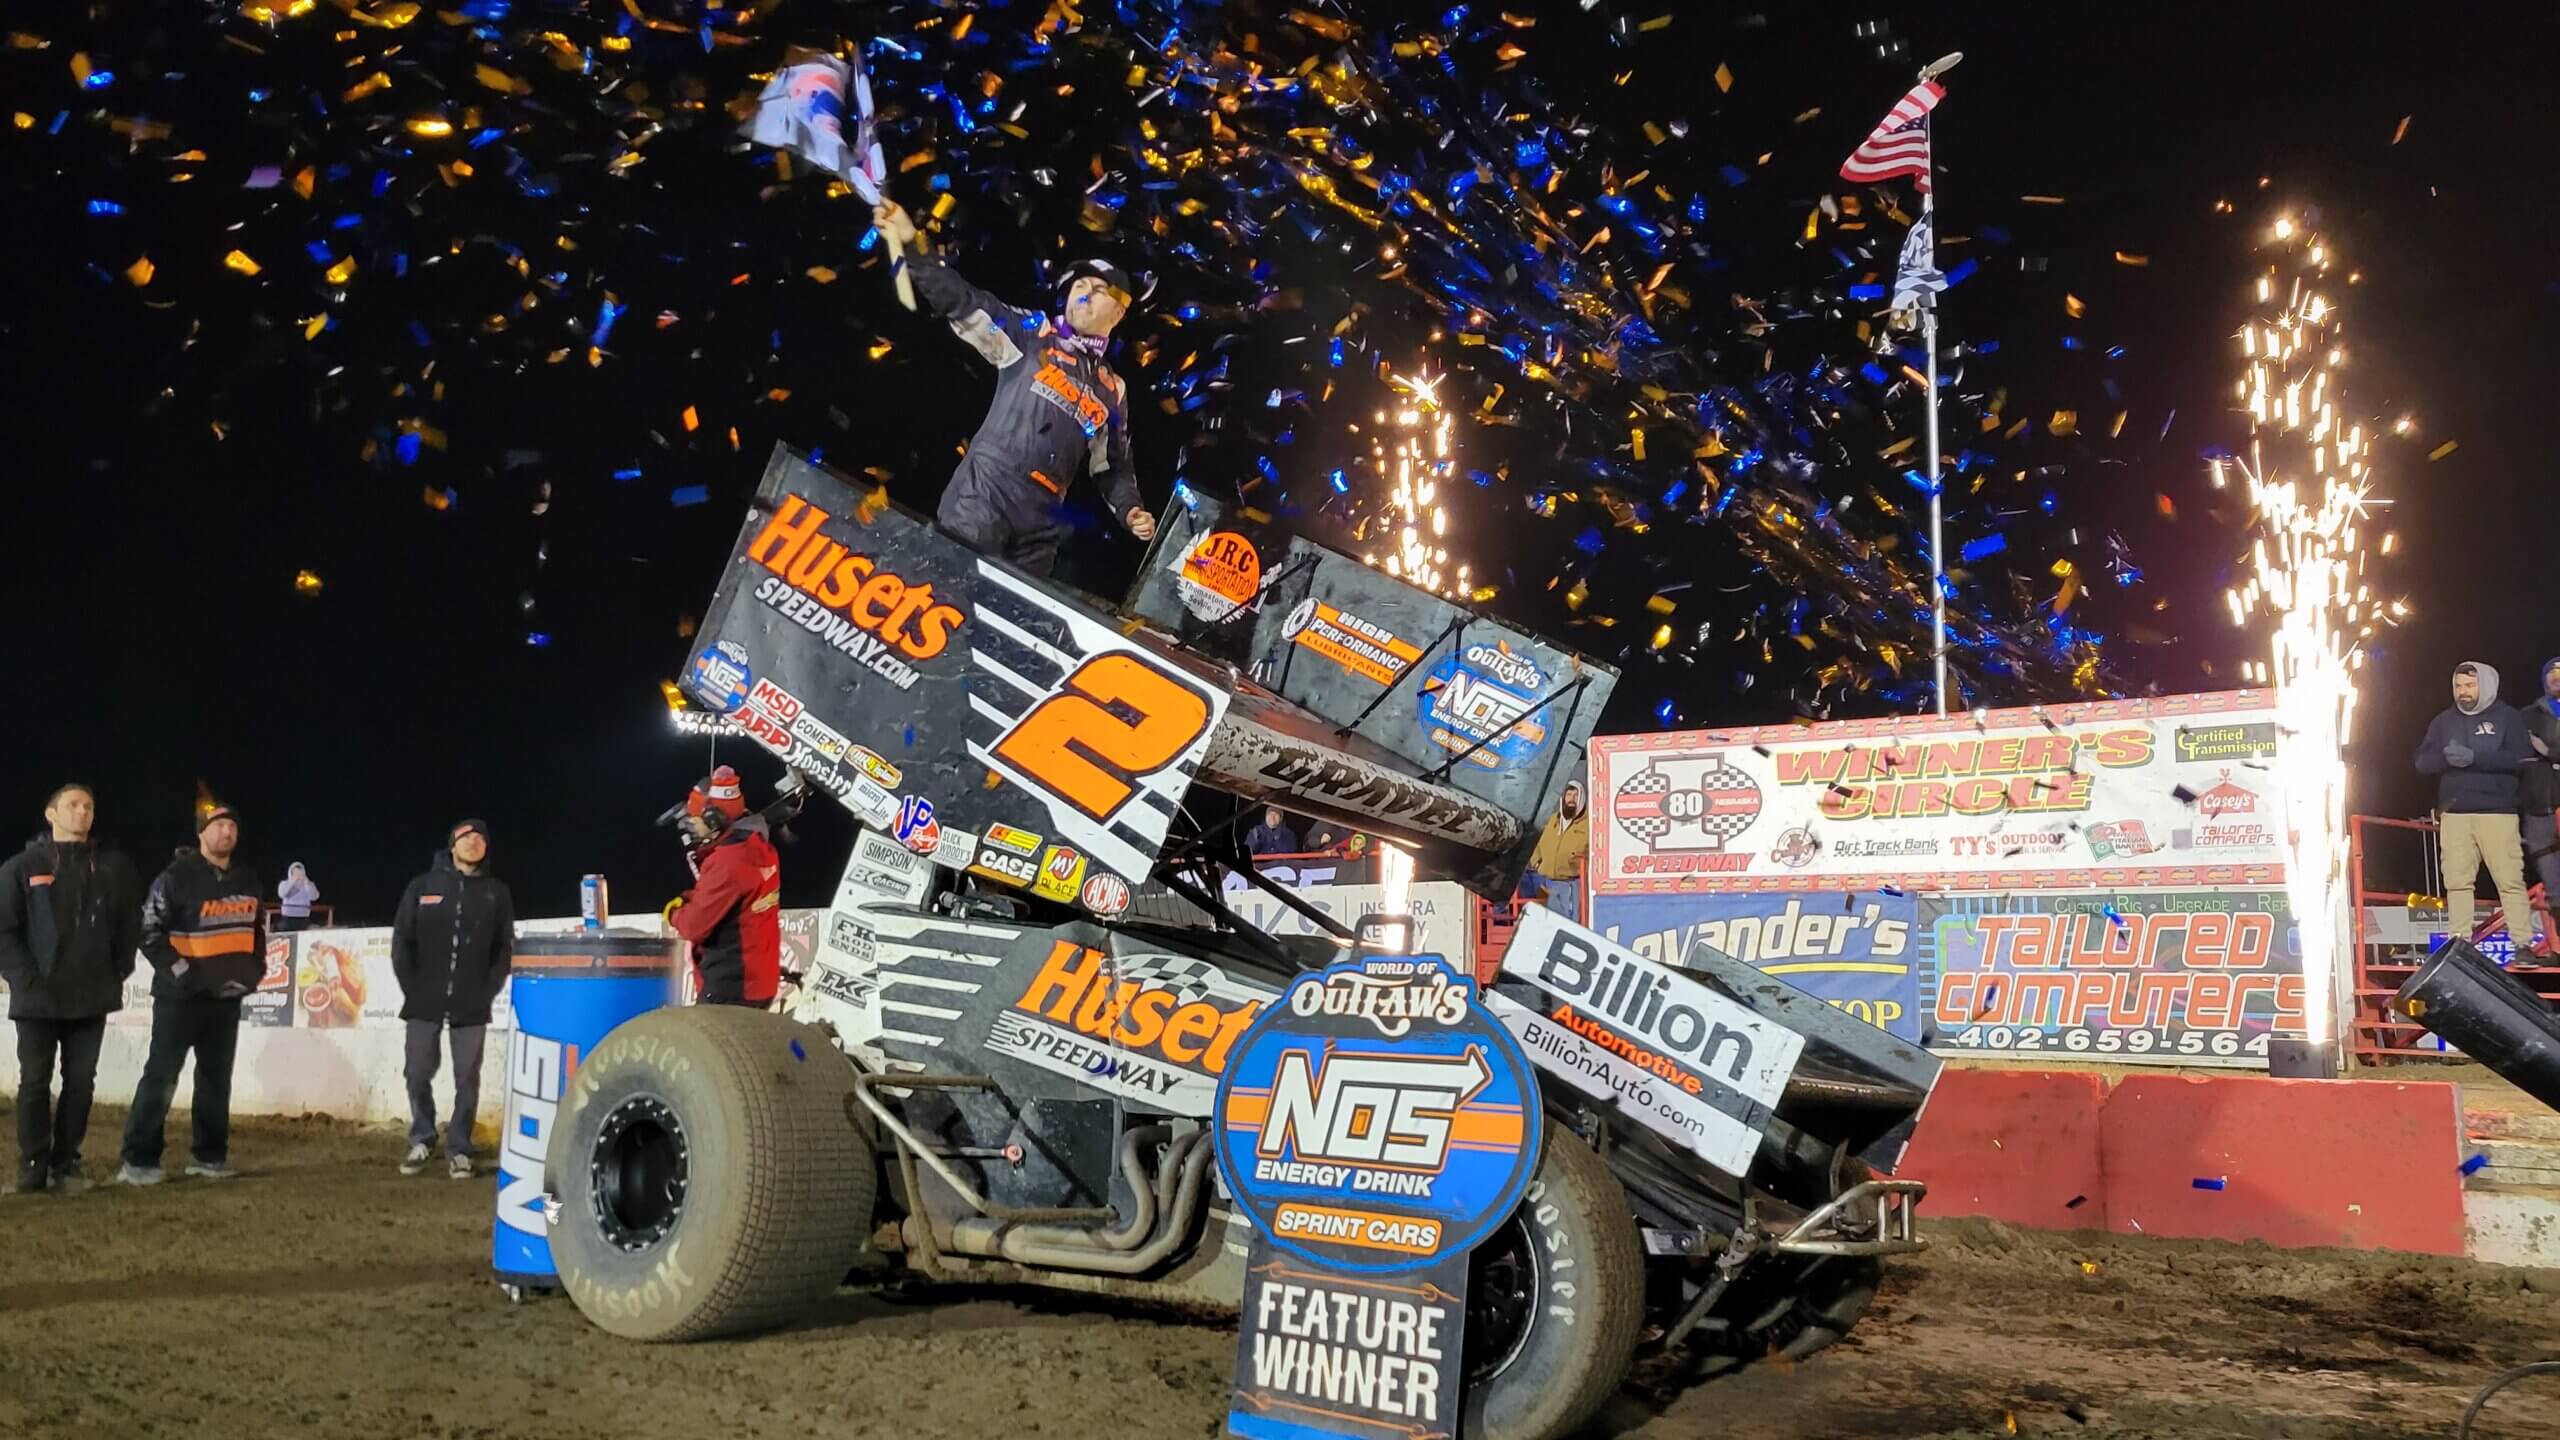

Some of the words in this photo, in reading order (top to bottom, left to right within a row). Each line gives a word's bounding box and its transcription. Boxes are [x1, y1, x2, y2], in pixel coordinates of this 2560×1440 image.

[1204, 537, 1255, 573] J.R.C
[748, 492, 964, 660] Husets
[754, 577, 921, 691] SPEEDWAY.COM
[1337, 611, 1395, 645] HIGH
[703, 655, 745, 693] NOS
[1467, 646, 1541, 689] OUTLAWS
[754, 682, 799, 719] MSD
[1436, 671, 1537, 739] NOS
[733, 706, 791, 748] ARP
[997, 654, 1209, 819] 2
[1430, 708, 1470, 733] ENERGY
[2178, 728, 2244, 750] Certified
[781, 741, 852, 796] Hoosier
[1775, 727, 2157, 785] WINNER'S
[2186, 740, 2275, 760] Transmission
[1668, 792, 1704, 817] 80
[1818, 771, 2096, 822] CIRCLE
[2203, 793, 2251, 810] Casey's
[896, 794, 934, 842] VP
[865, 841, 913, 870] SIMPSON
[1622, 853, 1756, 874] SPEEDWAY
[1834, 840, 1861, 851] Dirt
[1864, 839, 1902, 851] Track
[1904, 838, 1940, 850] Bank
[980, 849, 1039, 881] CASE
[1047, 853, 1081, 879] MY
[1088, 874, 1127, 913] ACME
[2162, 895, 2230, 913] UPGRADE
[2257, 894, 2289, 912] REP
[830, 938, 871, 958] ENDS
[841, 934, 873, 951] ROD
[1366, 962, 1415, 975] WORLD
[1416, 962, 1438, 975] OF
[1016, 939, 1264, 1073] Huset
[1291, 972, 1468, 1037] OUTLAWS
[1538, 928, 1754, 1082] Billion
[1551, 1005, 1703, 1095] Automotive
[1956, 1025, 2271, 1056] 402-659-564
[1012, 1028, 1184, 1096] SPEEDWAY
[1522, 1022, 1706, 1138] BillionAuto.com
[1258, 1048, 1489, 1170] NOS
[497, 1029, 562, 1237] NOS
[1255, 1160, 1351, 1189] ENERGY
[1353, 1170, 1436, 1197] DRINK
[1279, 1210, 1365, 1239] SPRINT
[1367, 1220, 1438, 1248] CARS
[1528, 1180, 1577, 1327] oosier
[1258, 1281, 1446, 1361] FEATURE
[1252, 1332, 1440, 1421] WINNER
